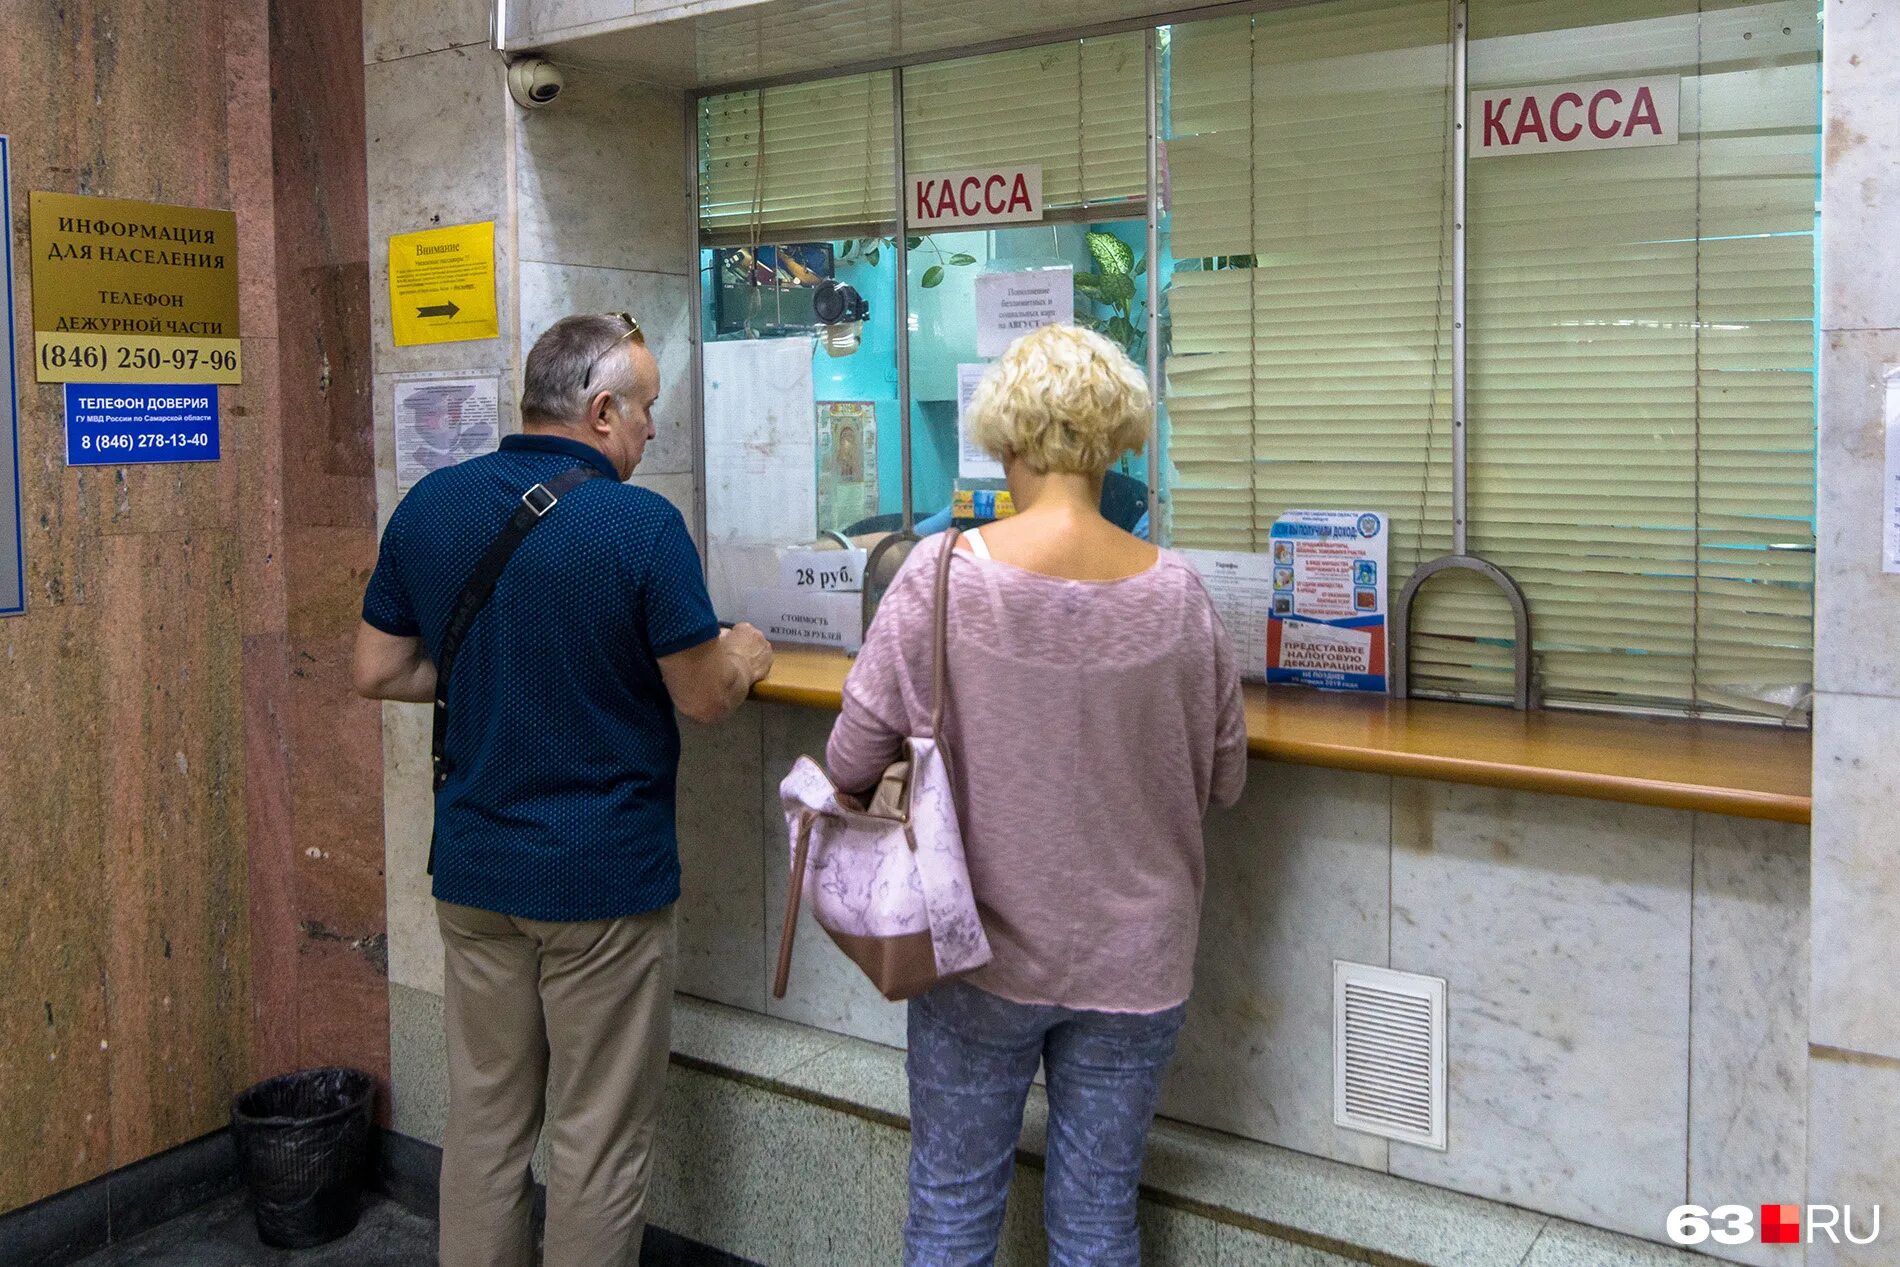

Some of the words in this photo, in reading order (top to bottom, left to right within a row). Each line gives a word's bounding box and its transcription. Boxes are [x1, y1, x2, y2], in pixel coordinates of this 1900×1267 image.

[1483, 86, 1663, 147] КАССА
[917, 173, 1033, 219] КАССА
[58, 217, 215, 244] ИНФОРМАЦИЯ
[48, 243, 92, 260] ДЛЯ
[99, 246, 224, 269] НАСЕЛЕНИЯ
[416, 243, 460, 256] Внимание
[99, 291, 183, 308] ТЕЛЕФОН
[56, 316, 161, 333] ДЕЖУРНОЙ
[166, 320, 222, 334] ЧАСТИ
[1009, 320, 1040, 329] АВГУСТ
[42, 343, 107, 371] (846)
[118, 347, 237, 370] 250-97-96
[79, 398, 144, 409] ТЕЛЕФОН
[147, 398, 208, 410] ДОВЕРИЯ
[82, 435, 91, 449] 8
[96, 434, 134, 452] (846)
[138, 433, 208, 448] 278-13-40
[797, 568, 814, 586] 28
[820, 566, 853, 588] руб.
[781, 614, 829, 626] СТОИМОСТЬ
[770, 627, 802, 637] ЖЕТОНА
[812, 630, 842, 641] РУБЛЕЙ
[1284, 642, 1364, 654] ПРЕДСТАВЬТЕ
[1287, 651, 1362, 662] НАЛОГОВУЮ
[1284, 660, 1366, 672] ДЕКЛАРАЦИЮ
